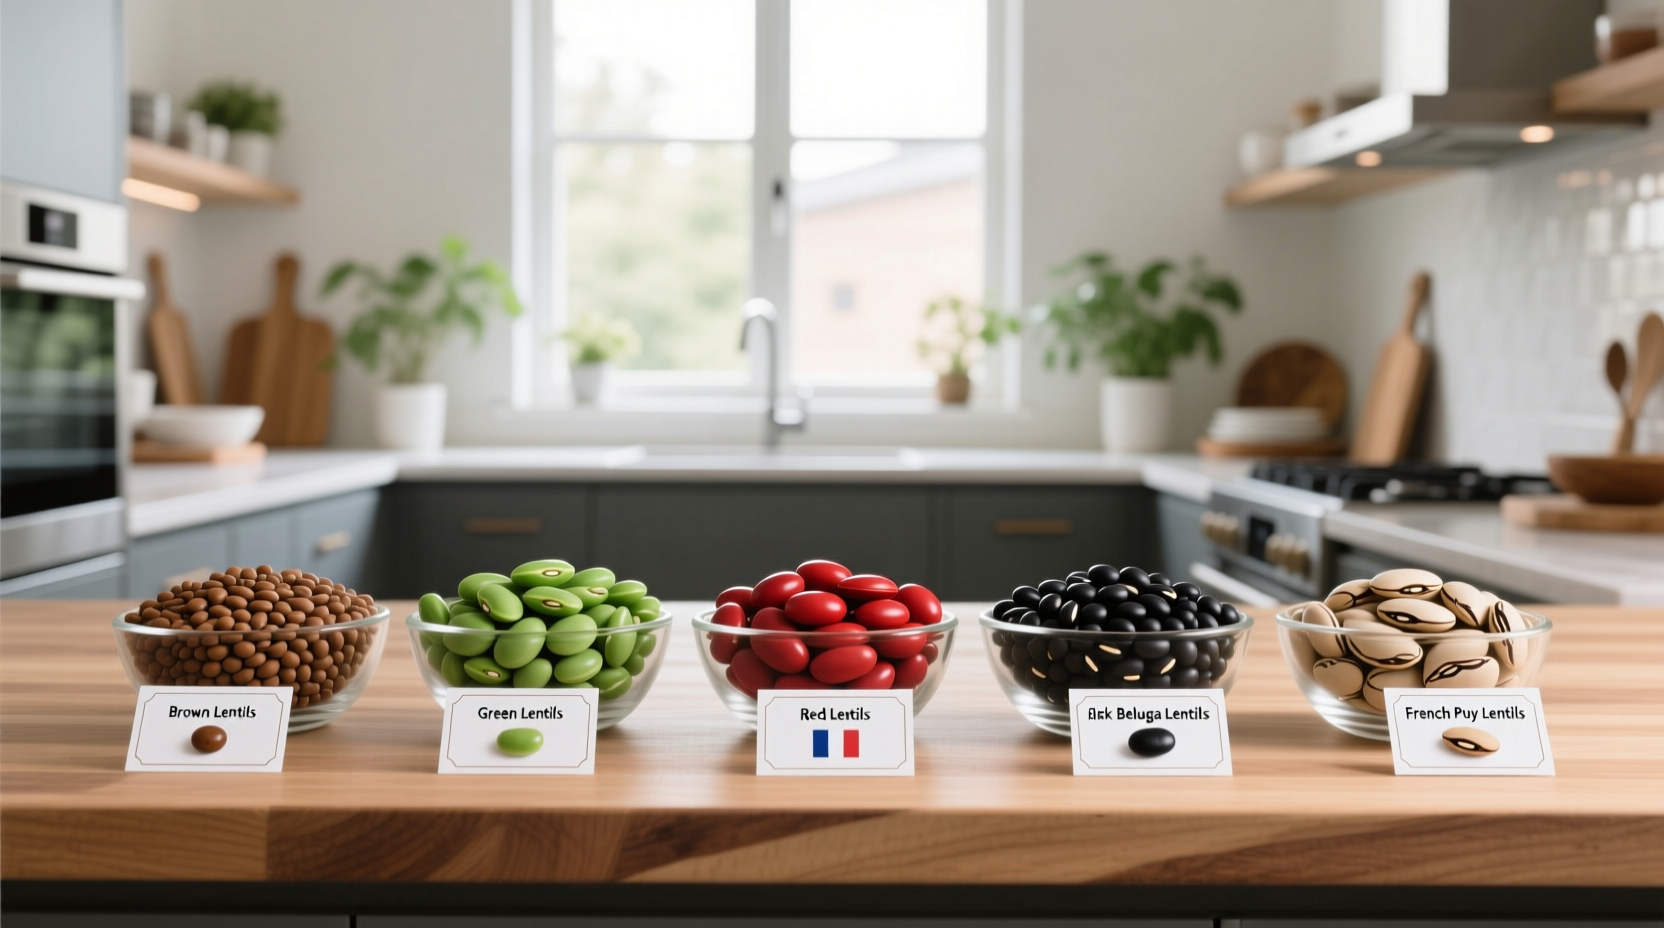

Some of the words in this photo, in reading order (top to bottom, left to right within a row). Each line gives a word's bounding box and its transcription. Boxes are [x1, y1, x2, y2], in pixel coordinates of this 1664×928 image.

[168, 705, 210, 719] Brown
[213, 705, 257, 719] Lentils
[477, 706, 517, 720] Green
[520, 705, 564, 720] Lentils
[800, 707, 827, 721] Red
[1116, 706, 1162, 723] Beluga
[1165, 706, 1210, 720] Lentils
[1405, 706, 1451, 720] French
[1454, 706, 1479, 723] Puy
[1482, 706, 1526, 720] Lentils
